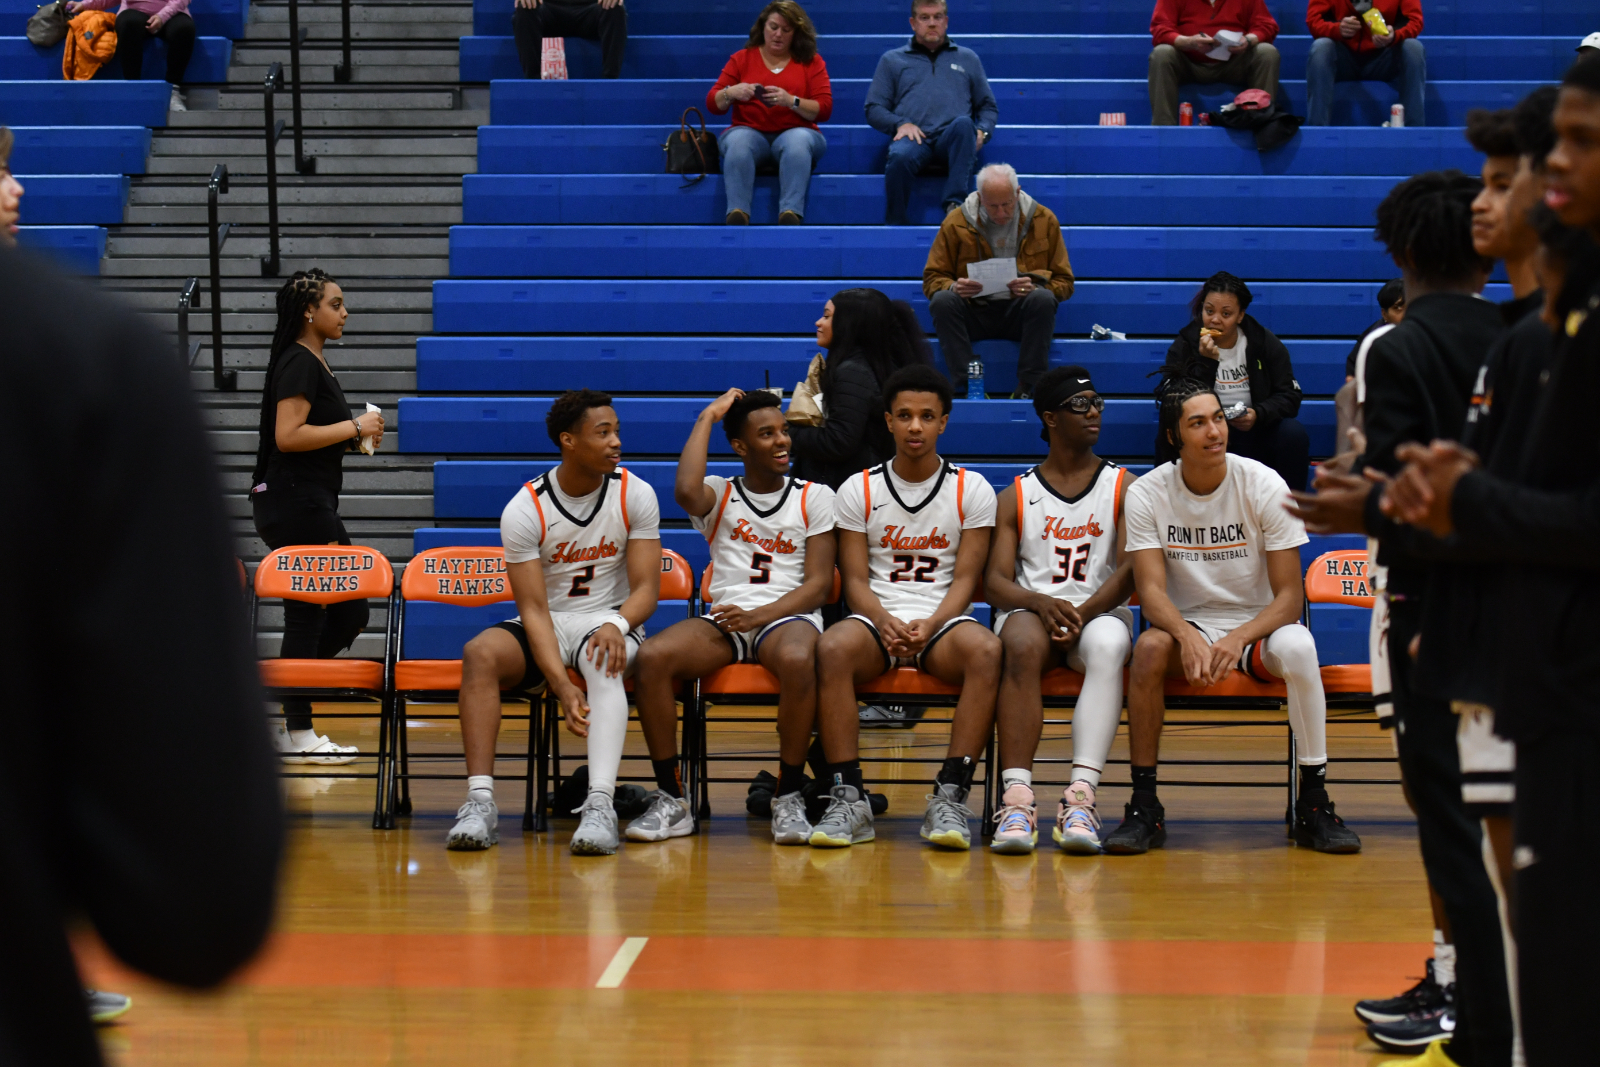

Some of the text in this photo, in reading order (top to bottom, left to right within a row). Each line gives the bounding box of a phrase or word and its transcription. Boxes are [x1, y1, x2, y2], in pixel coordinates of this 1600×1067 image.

[730, 518, 797, 555] Hawks
[879, 525, 950, 550] Hawks
[1042, 514, 1104, 540] Hawks
[1167, 523, 1246, 545] RUN IT BACK
[549, 536, 618, 564] Hawks
[1167, 548, 1249, 561] HAYFIELD BASKETBALL
[276, 555, 373, 572] HAYFIELD
[423, 557, 508, 575] HAYFIEL
[750, 552, 772, 584] 5
[890, 555, 940, 583] 22
[1051, 543, 1091, 584] 32
[290, 575, 359, 592] HAWKS
[437, 577, 505, 595] HAWKS
[568, 565, 595, 597] 2
